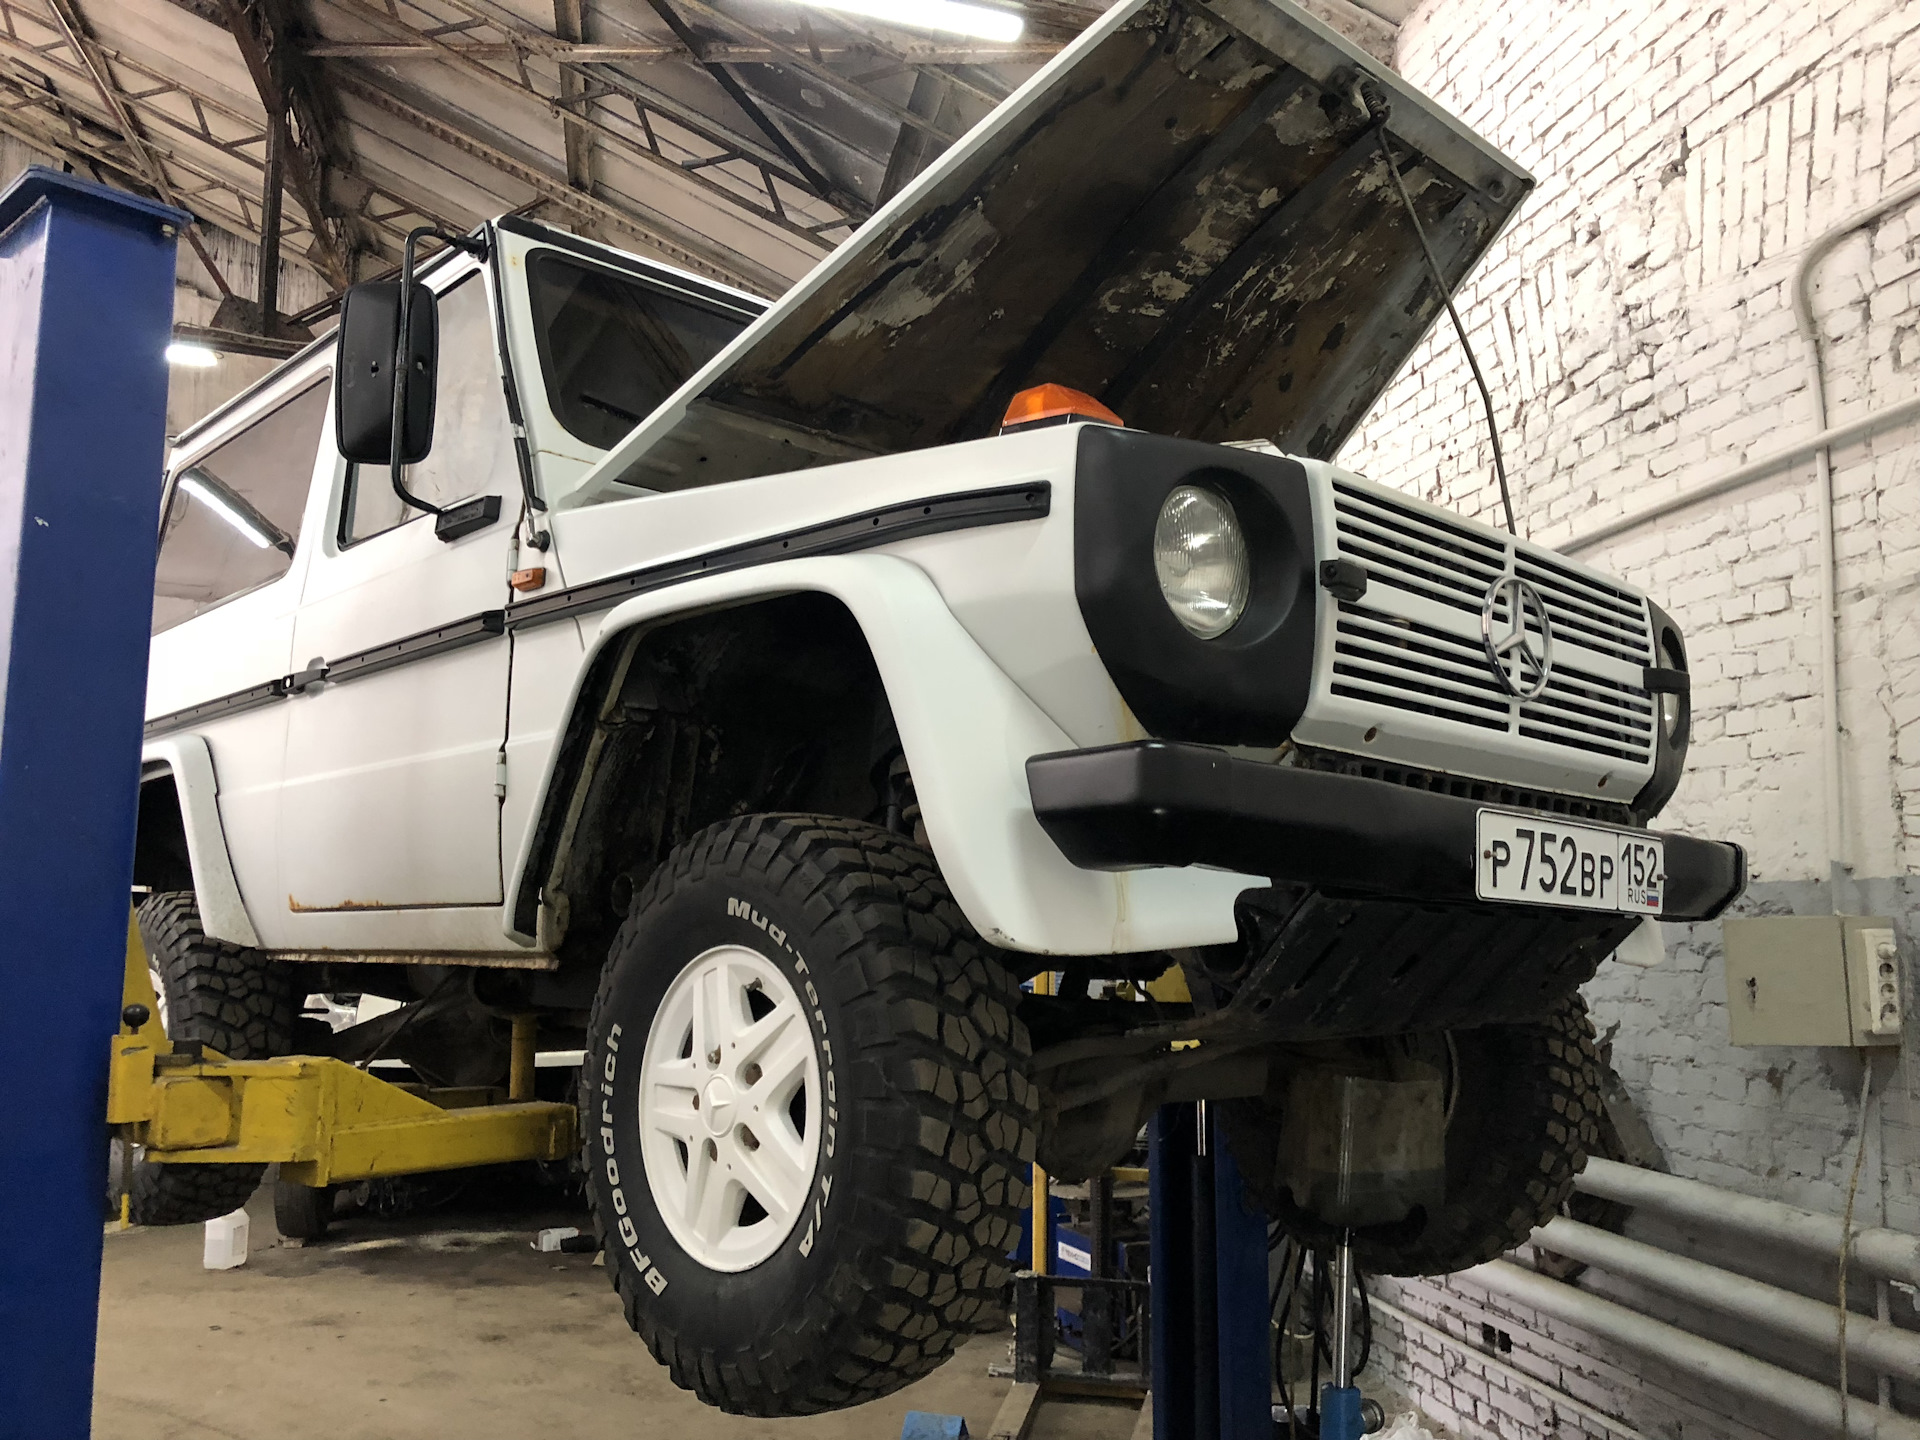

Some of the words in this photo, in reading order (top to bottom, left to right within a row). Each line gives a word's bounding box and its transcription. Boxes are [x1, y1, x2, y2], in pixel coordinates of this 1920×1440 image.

[1621, 843, 1658, 888] 152
[1628, 888, 1646, 905] RUS
[727, 897, 838, 1158] Mud-Terrain
[798, 1174, 833, 1258] T/A
[600, 1023, 668, 1296] BFGoodrich
